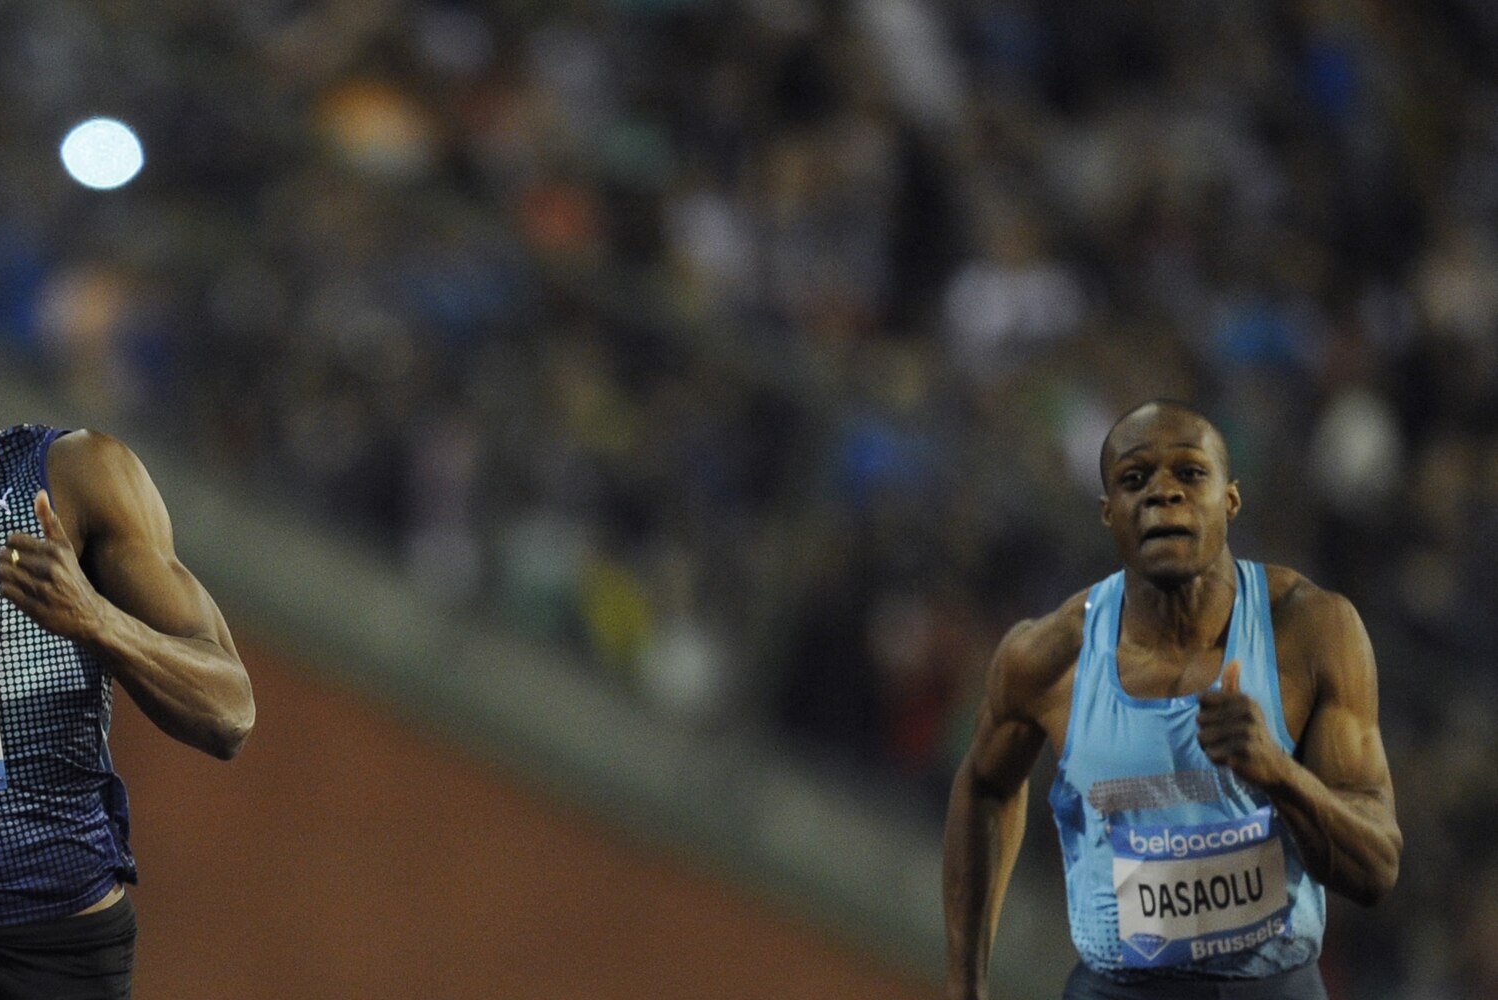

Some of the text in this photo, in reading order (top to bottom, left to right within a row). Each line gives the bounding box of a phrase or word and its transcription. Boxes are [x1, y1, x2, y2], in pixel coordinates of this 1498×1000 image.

[1129, 821, 1263, 857] belgacom
[1138, 867, 1264, 918] DASAOLU
[1190, 917, 1286, 960] Brussels
